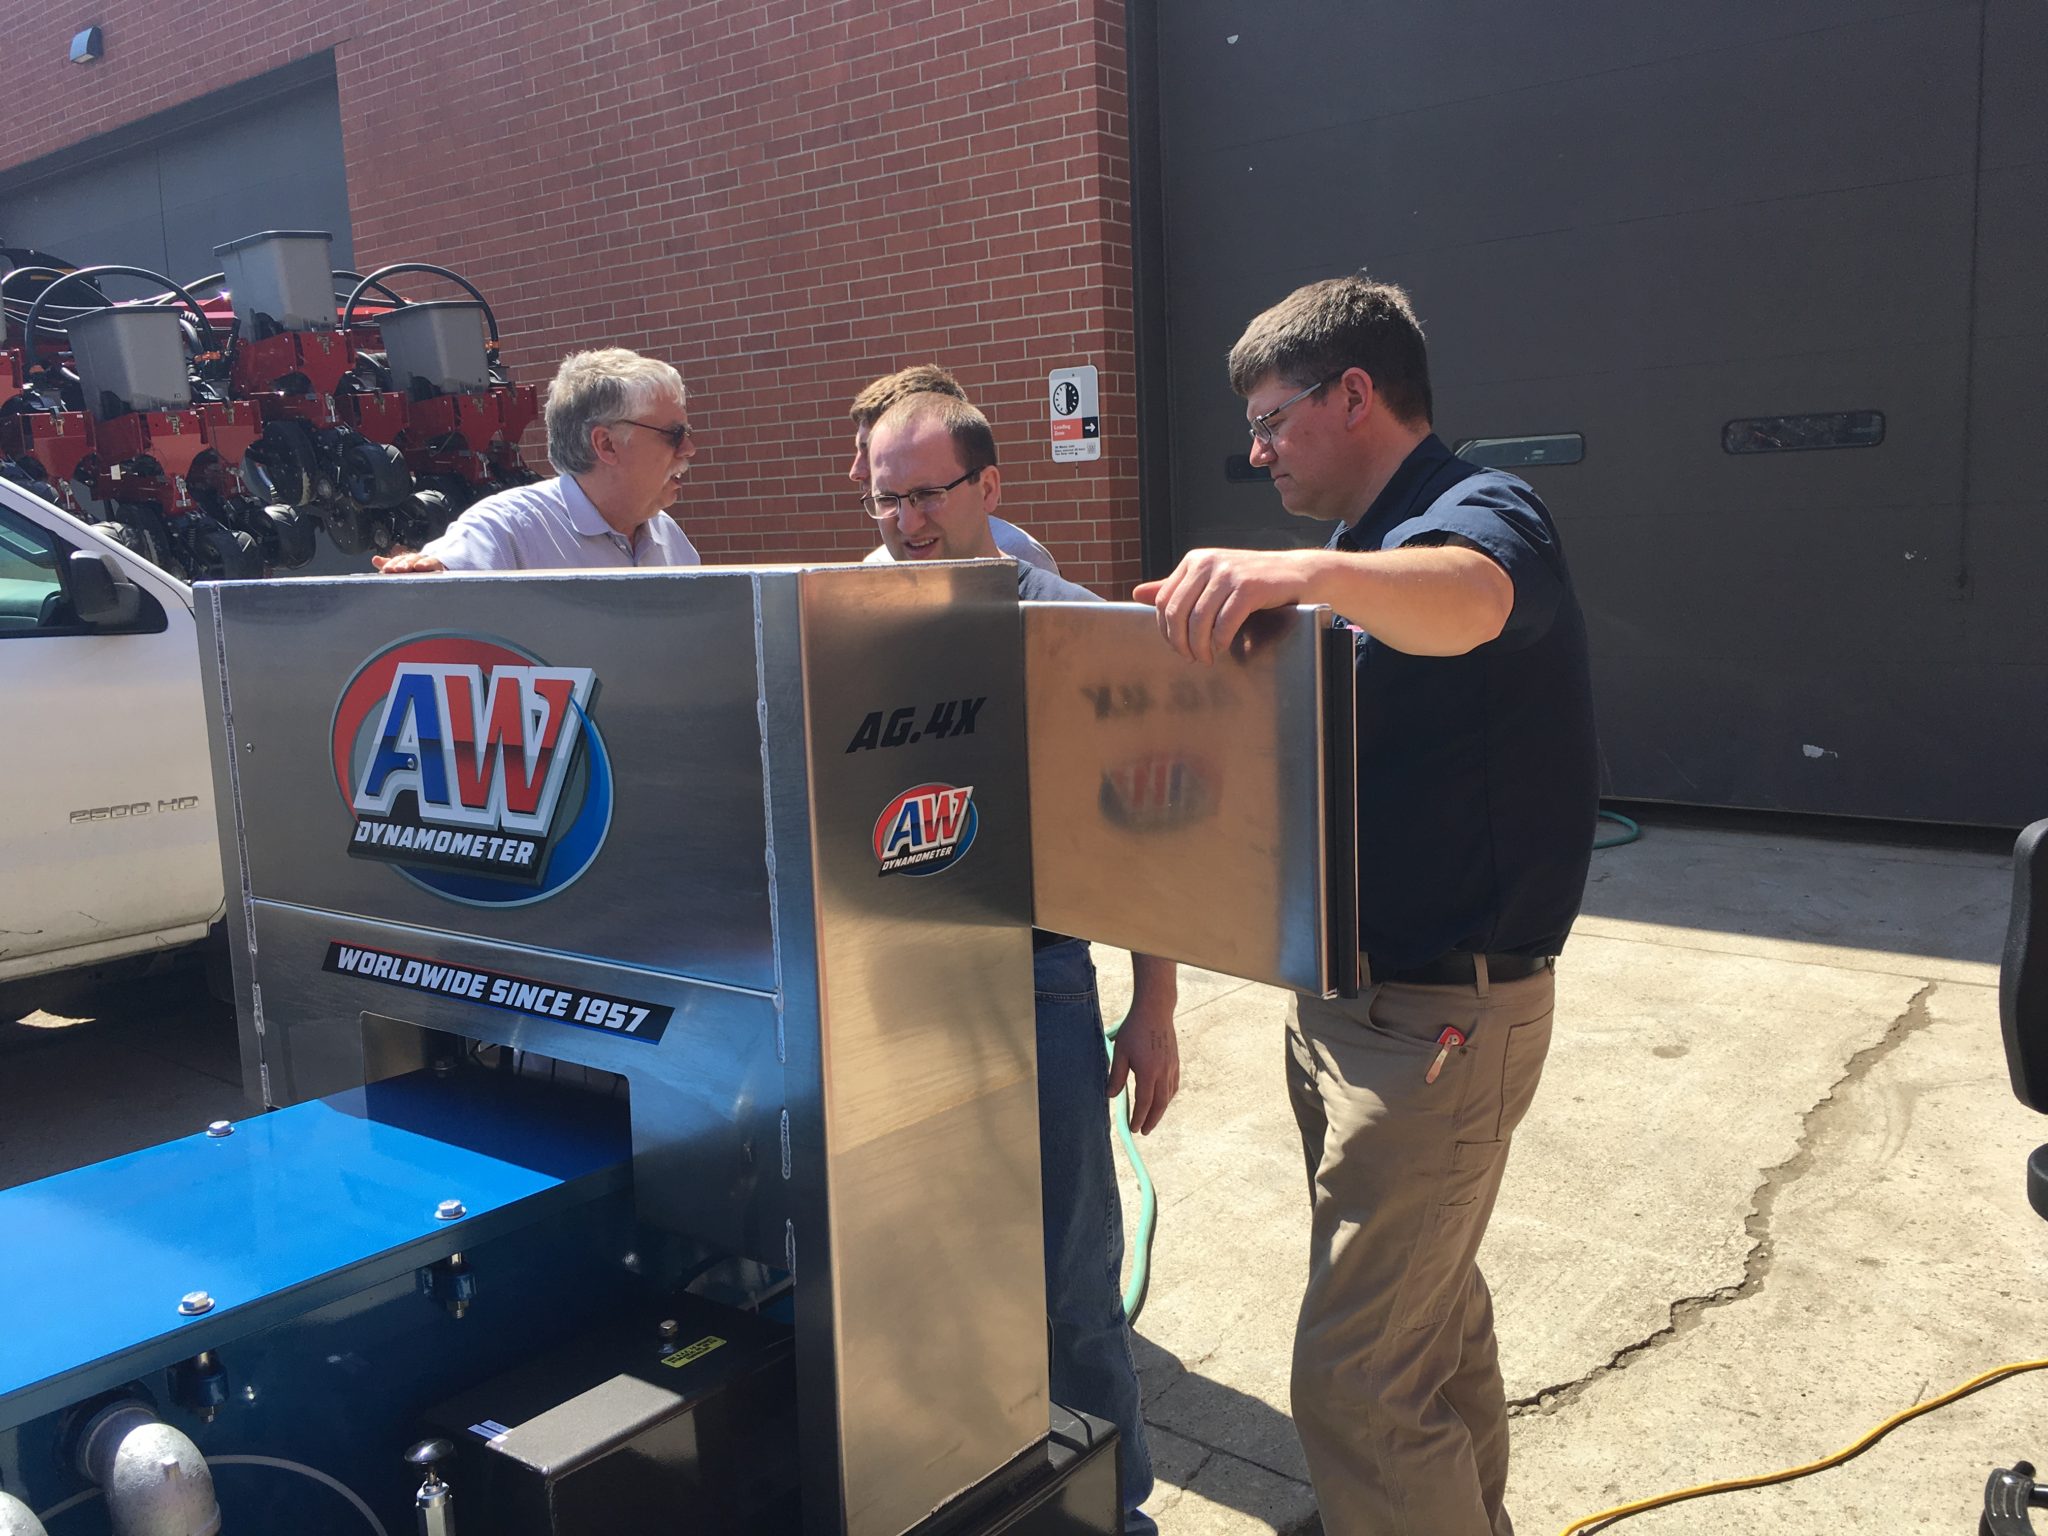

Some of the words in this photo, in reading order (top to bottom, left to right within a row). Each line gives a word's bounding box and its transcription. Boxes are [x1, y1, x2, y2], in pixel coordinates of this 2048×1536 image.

[354, 662, 596, 837] AW
[845, 697, 987, 753] AG.4X
[70, 802, 151, 824] 2500
[158, 796, 199, 812] HD
[882, 786, 974, 858] AW
[354, 821, 535, 865] DYNAMOMETER
[882, 846, 953, 871] DYNAMOMETER
[337, 947, 485, 998] WORLDWIDE
[490, 978, 573, 1017] SINCE
[574, 996, 650, 1033] 1957
